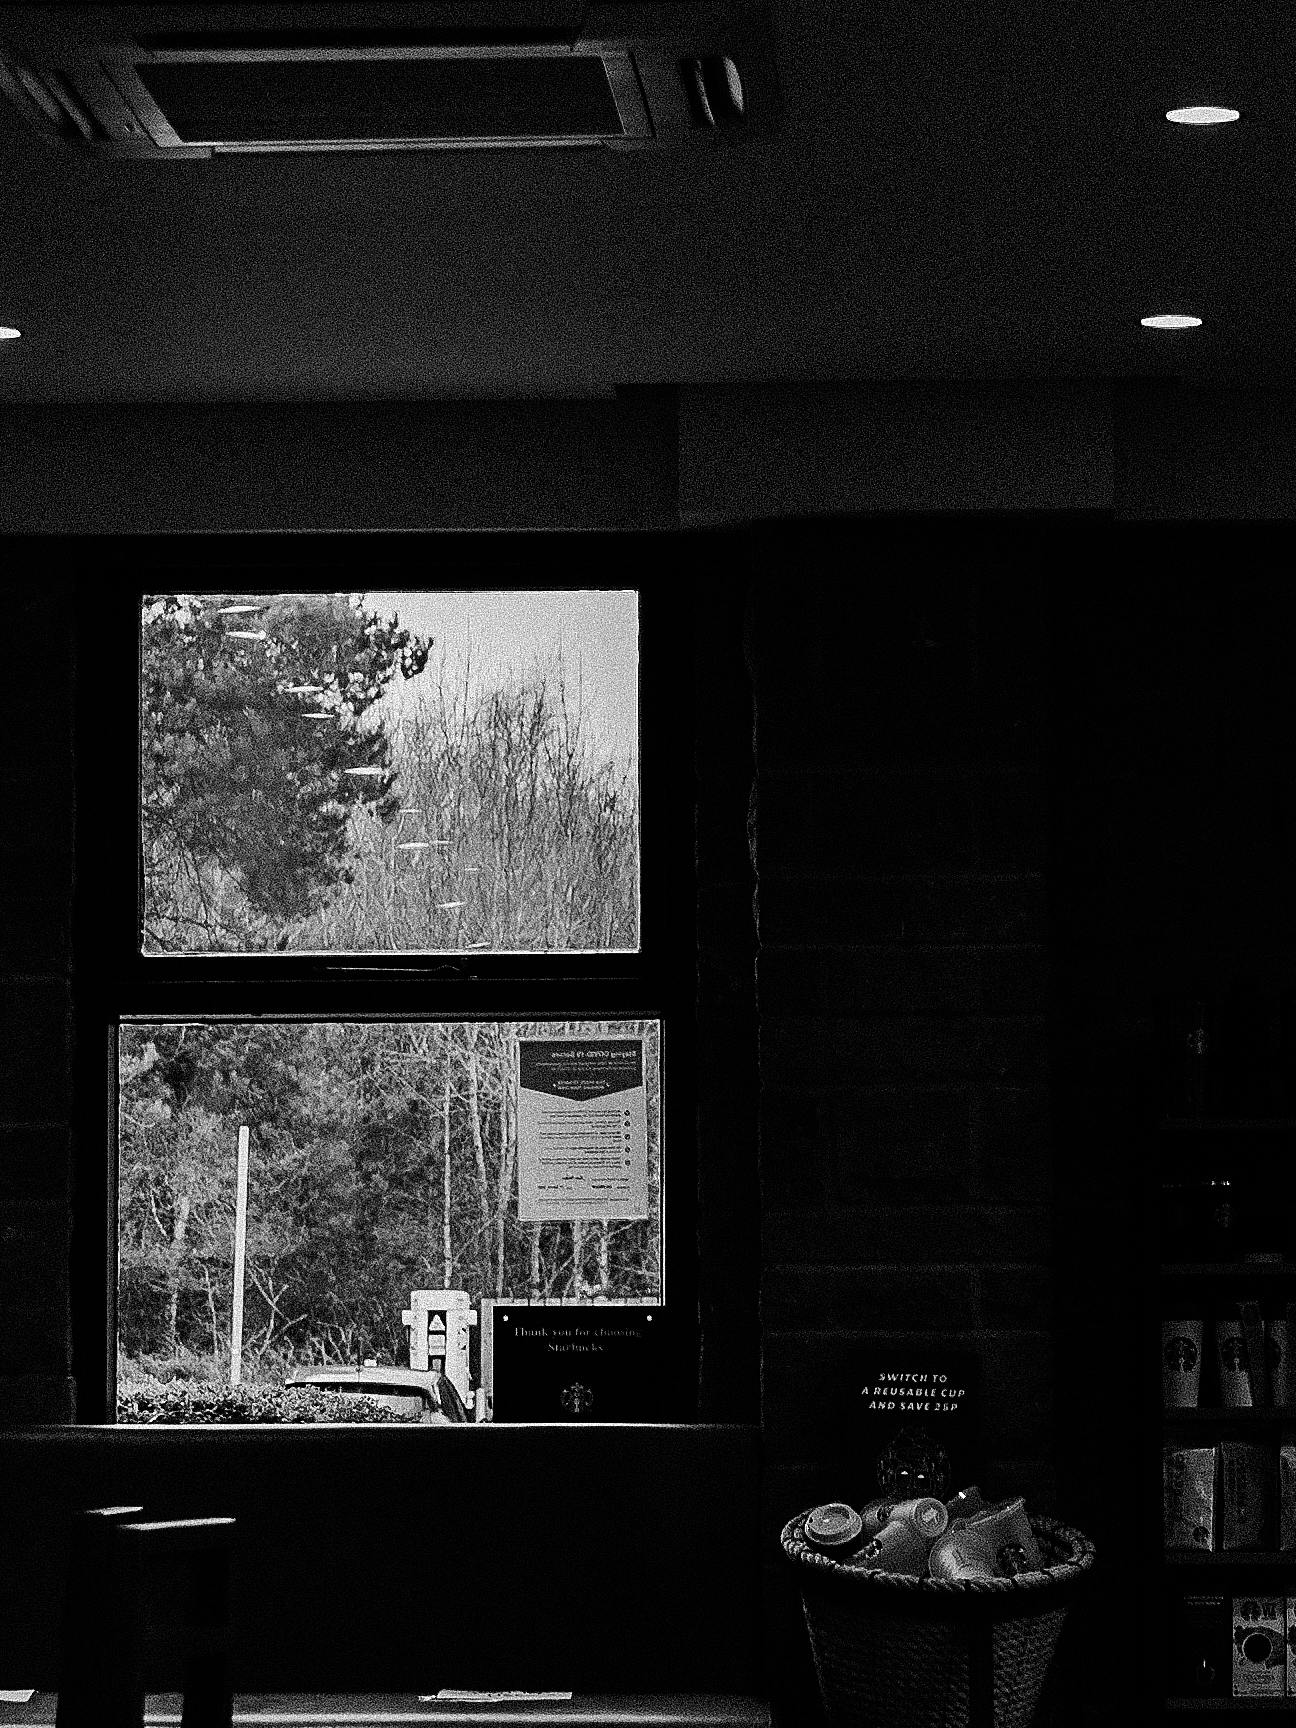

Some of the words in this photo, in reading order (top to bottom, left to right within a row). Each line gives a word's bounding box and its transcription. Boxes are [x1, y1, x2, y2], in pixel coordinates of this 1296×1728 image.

[514, 1326, 549, 1337] Thank
[552, 1328, 572, 1339] you
[574, 1327, 591, 1337] for
[593, 1327, 643, 1339] choosing
[547, 1342, 605, 1352] Starbucks
[878, 1372, 929, 1383] SWITCH
[932, 1373, 949, 1384] TO
[860, 1385, 870, 1396] A
[873, 1386, 937, 1397] REUSABLE
[940, 1388, 966, 1398] CUP
[868, 1400, 896, 1410] AND
[899, 1401, 931, 1412] SAVE
